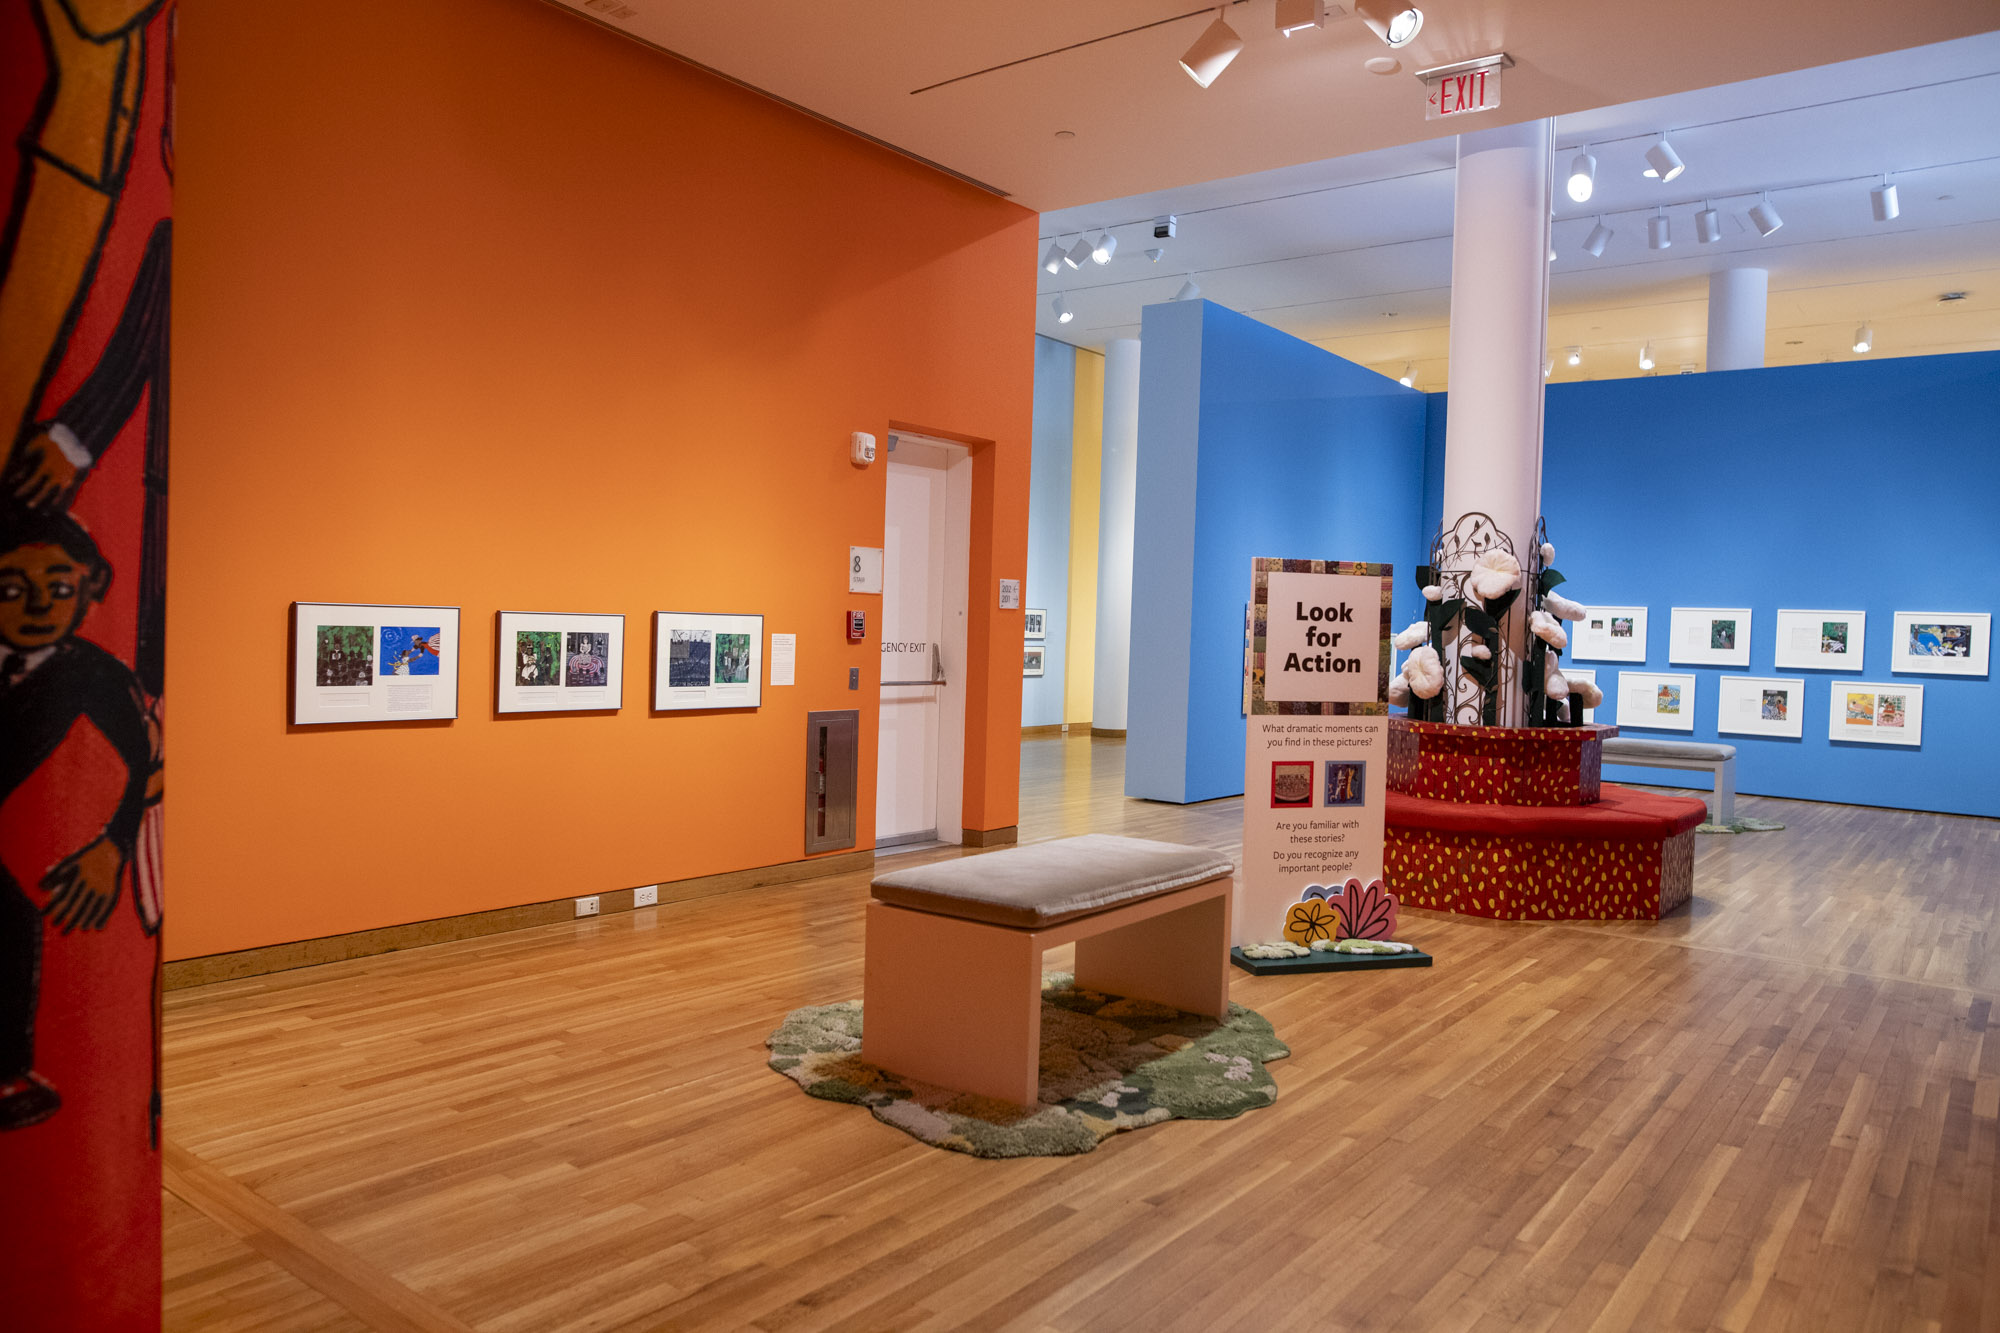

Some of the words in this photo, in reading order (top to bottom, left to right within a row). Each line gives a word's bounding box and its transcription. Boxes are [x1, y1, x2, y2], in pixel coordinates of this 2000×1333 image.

[1440, 70, 1490, 115] EXIT
[853, 555, 861, 573] 8
[1296, 602, 1354, 623] Look
[1306, 626, 1342, 647] for
[909, 642, 927, 653] EXIT
[1283, 651, 1361, 673] Action
[1262, 724, 1285, 733] What
[1286, 724, 1323, 733] dramatic
[1325, 725, 1363, 733] moments
[1364, 725, 1379, 733] can
[1267, 739, 1283, 749] you
[1285, 738, 1301, 746] find
[1303, 738, 1311, 746] in
[1312, 738, 1335, 747] these
[1336, 738, 1373, 748] pictures?
[1276, 822, 1291, 830] Are
[1292, 823, 1308, 832] you
[1309, 820, 1340, 830] familiar
[1342, 820, 1360, 829] with
[1290, 835, 1313, 843] these
[1314, 834, 1346, 843] stories?
[1273, 851, 1285, 860] Do
[1286, 852, 1302, 861] you
[1304, 850, 1343, 860] recognize
[1345, 850, 1359, 859] any
[1278, 864, 1320, 875] important
[1321, 863, 1353, 873] people?
